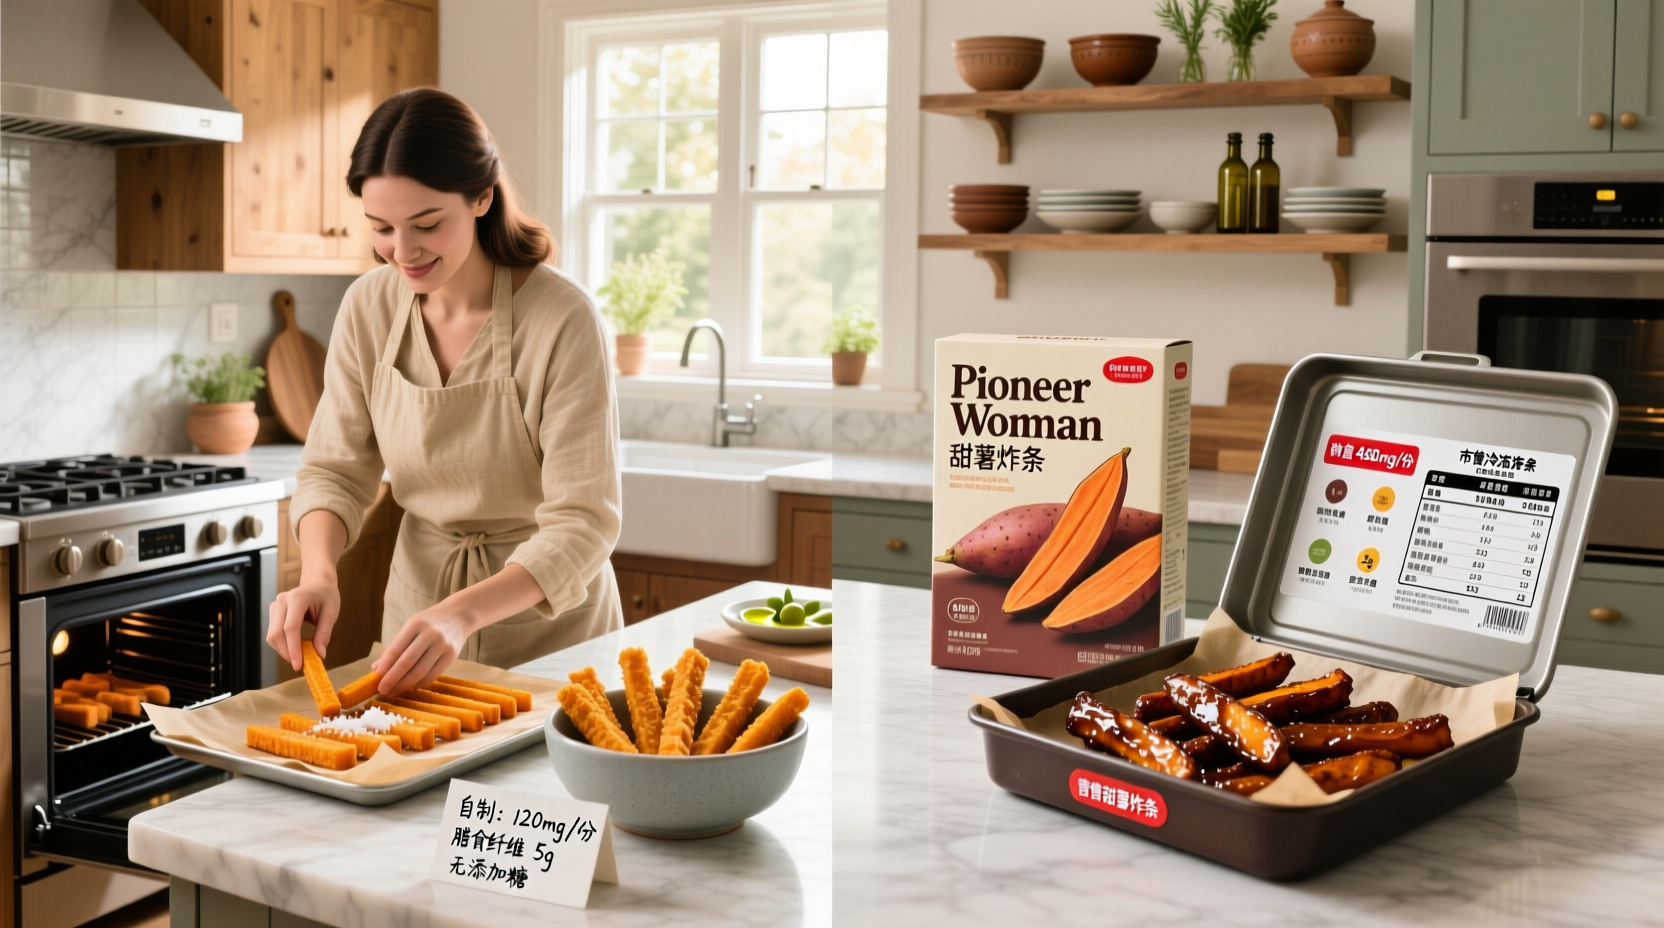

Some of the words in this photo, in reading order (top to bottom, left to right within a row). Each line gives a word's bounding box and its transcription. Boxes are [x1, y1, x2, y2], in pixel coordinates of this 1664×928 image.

[951, 364, 1091, 403] Pioneer
[950, 402, 1103, 441] Woman
[949, 443, 1045, 473] 甜薯炸条
[449, 856, 528, 889] 无添加糖
[533, 842, 554, 873] 5g
